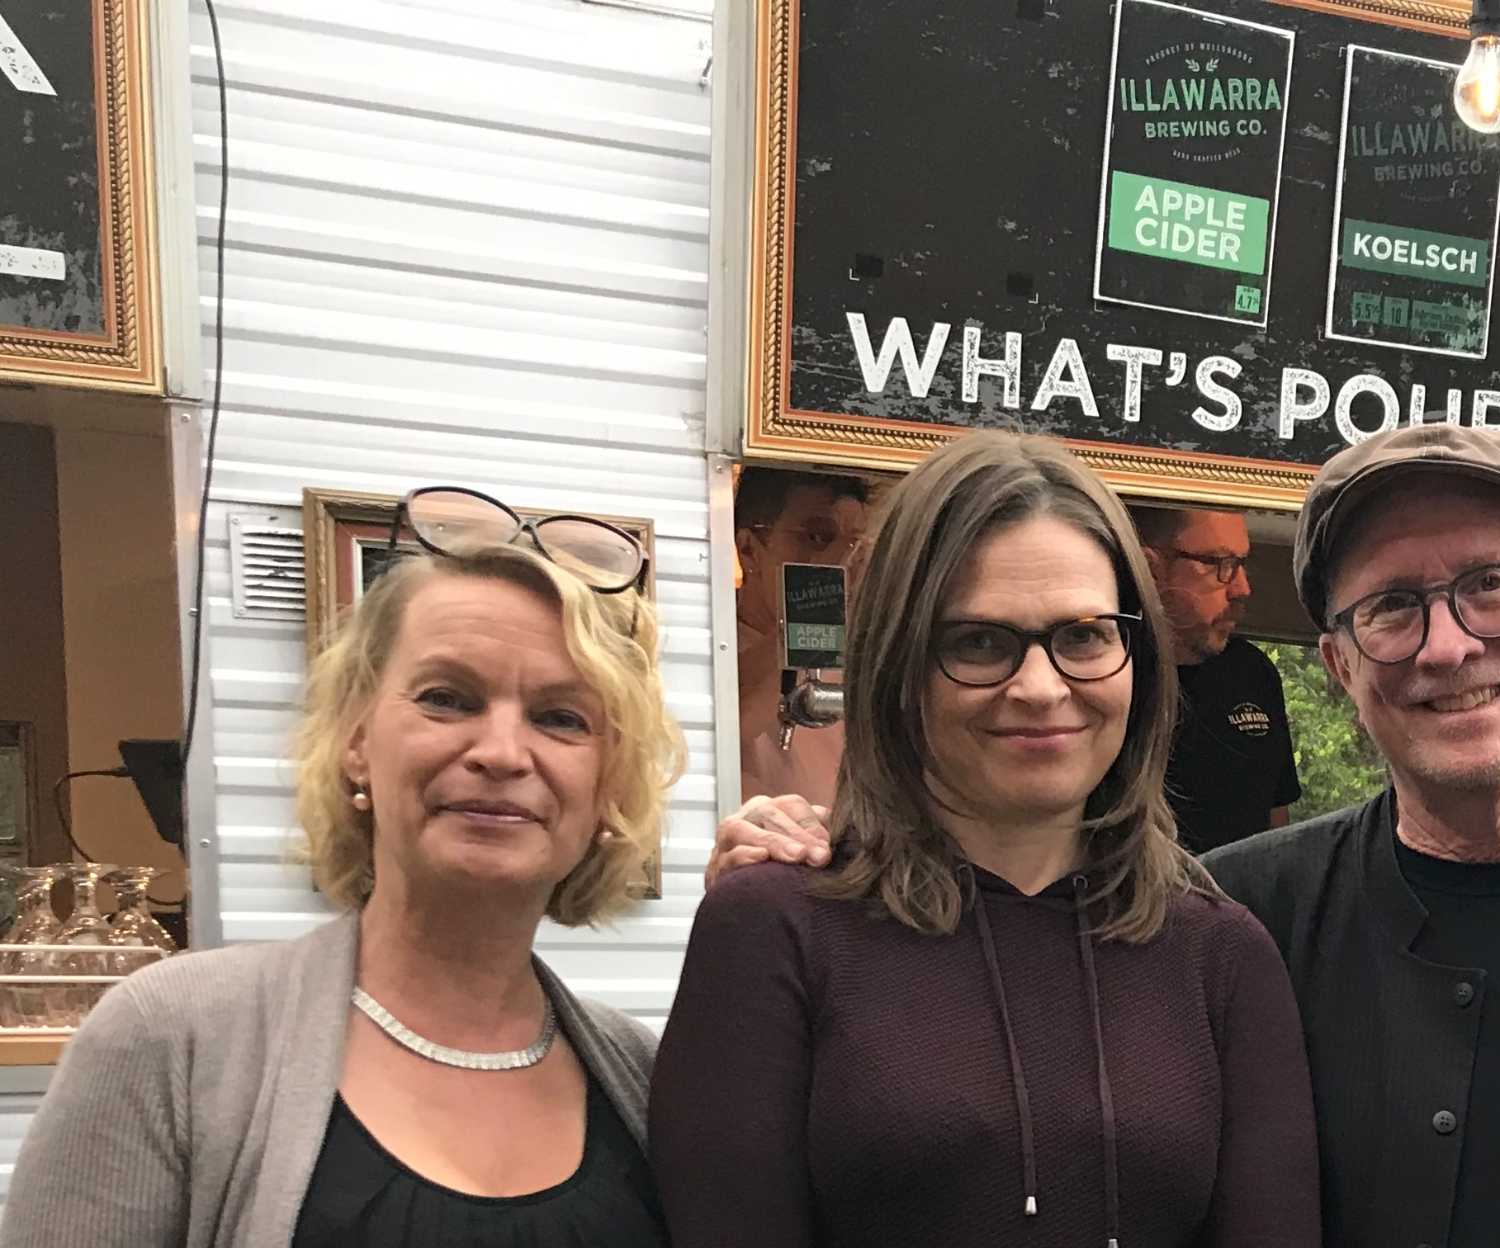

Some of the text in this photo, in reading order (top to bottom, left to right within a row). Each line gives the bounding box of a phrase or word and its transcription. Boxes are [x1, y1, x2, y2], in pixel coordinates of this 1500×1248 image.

[1120, 78, 1282, 112] ILLAWARRA
[1144, 119, 1268, 138] BREWING CO.
[1373, 161, 1453, 182] BREWING
[1134, 184, 1248, 231] APPLE
[1135, 217, 1241, 263] CIDER
[1353, 232, 1478, 274] KOELSCH
[845, 311, 1244, 432] WHAT'S
[797, 624, 838, 639] APPLE
